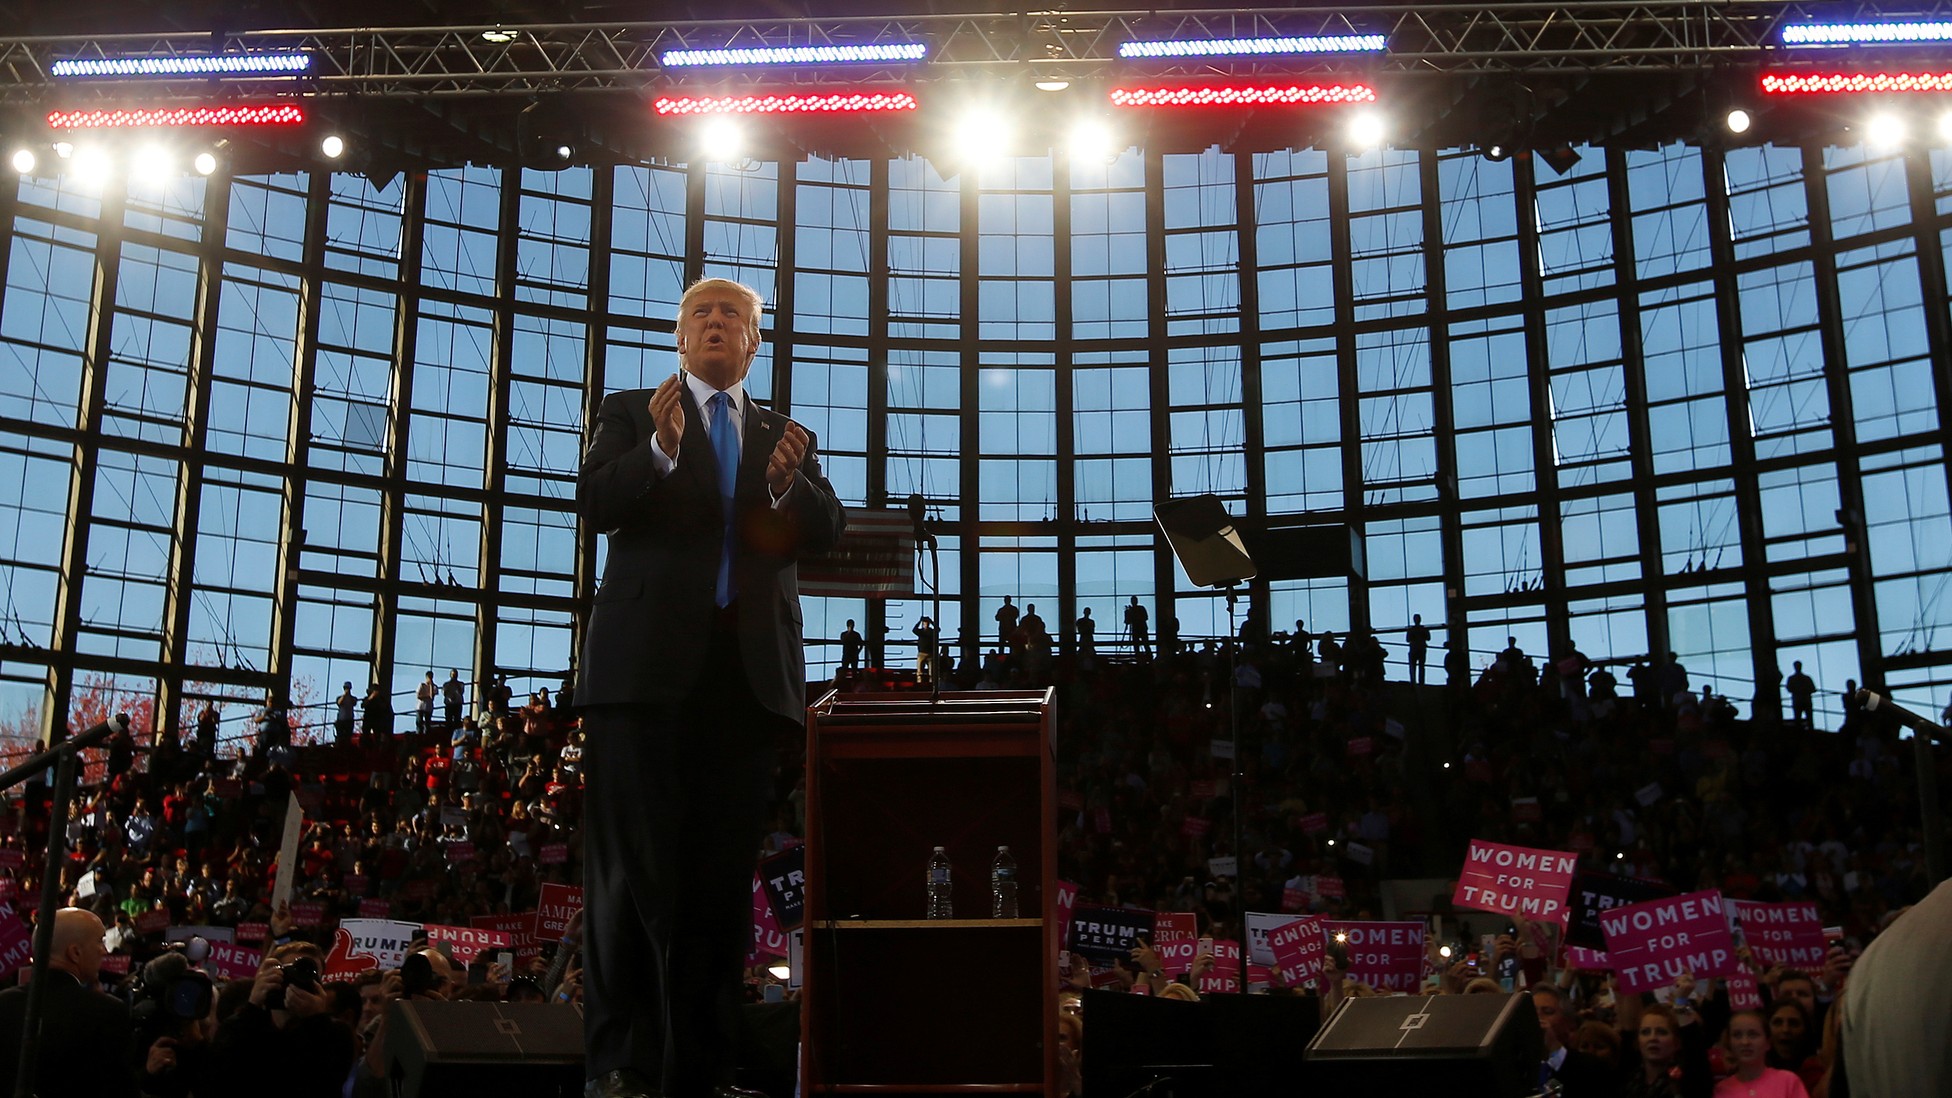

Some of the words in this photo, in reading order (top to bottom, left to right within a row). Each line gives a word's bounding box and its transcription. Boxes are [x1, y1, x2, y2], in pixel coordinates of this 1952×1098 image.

[1471, 845, 1576, 874] WOMEN
[1496, 874, 1534, 890] FOR
[1463, 885, 1558, 915] TRUMP
[1156, 920, 1173, 928] AKE
[1602, 895, 1722, 938] WOMEN
[1737, 906, 1819, 924] WOMEN
[496, 921, 523, 931] MAKE
[1274, 920, 1323, 947] RUMP
[353, 937, 410, 952] RUMP
[427, 926, 505, 946] TRUMP
[1079, 933, 1136, 948] PENC
[1154, 930, 1195, 943] ERICA
[1322, 928, 1422, 945] OMEN
[1647, 932, 1690, 952] FOR
[1762, 930, 1793, 942] FOR
[1162, 943, 1240, 959] WOEN
[1354, 953, 1391, 965] FOR
[1751, 945, 1824, 963] TRUMP
[1281, 957, 1322, 984] MEN
[1622, 949, 1727, 987] TRUMP
[1345, 972, 1416, 990] RUMP
